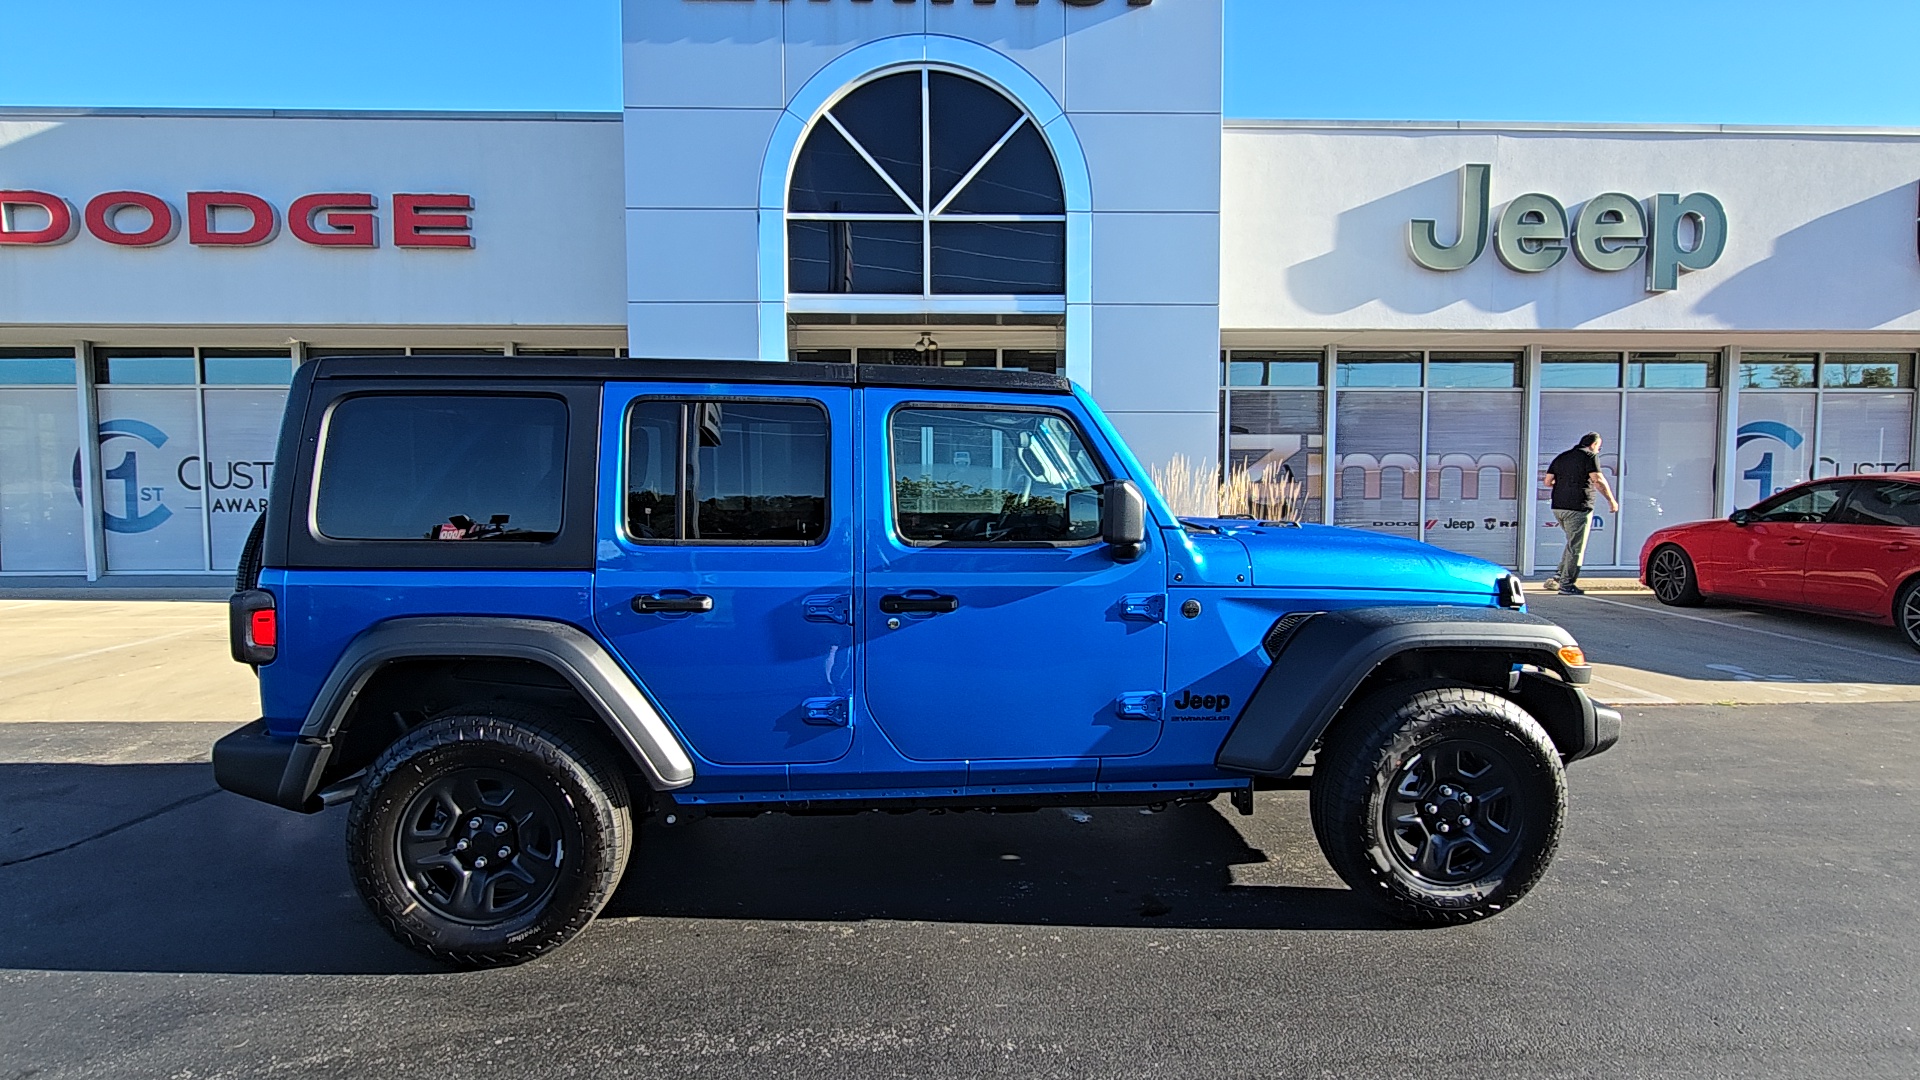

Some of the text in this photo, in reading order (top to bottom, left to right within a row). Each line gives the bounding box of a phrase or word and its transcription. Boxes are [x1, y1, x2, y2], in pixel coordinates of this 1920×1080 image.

[0, 188, 476, 249] DODGE
[1408, 163, 1728, 291] Jeep
[1443, 517, 1475, 531] Jeep
[1174, 690, 1230, 713] Jeep
